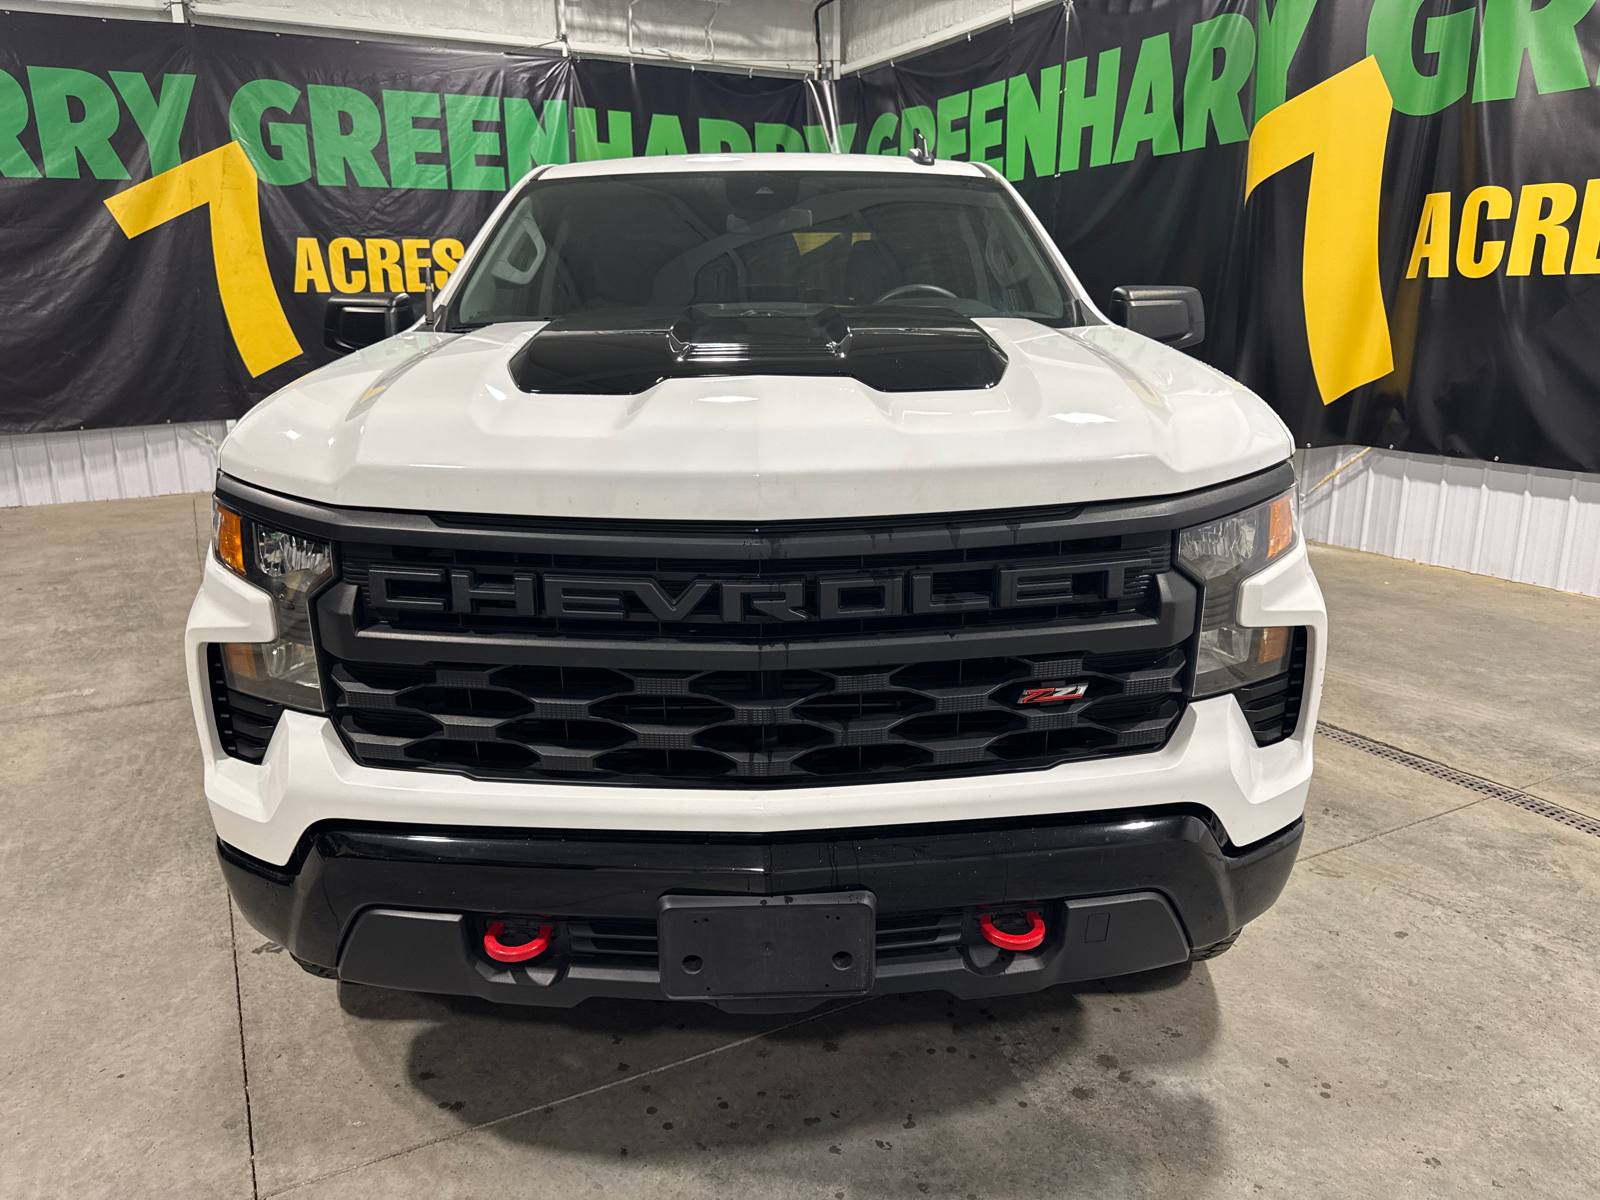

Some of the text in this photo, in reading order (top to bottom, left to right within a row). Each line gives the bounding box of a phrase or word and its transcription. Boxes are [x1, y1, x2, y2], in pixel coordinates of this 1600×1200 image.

[1365, 0, 1600, 116] GR
[103, 140, 465, 378] 7 ACRES
[1245, 54, 1394, 405] 7
[367, 551, 1152, 623] CHEVROLET
[1017, 683, 1089, 704] Z71
